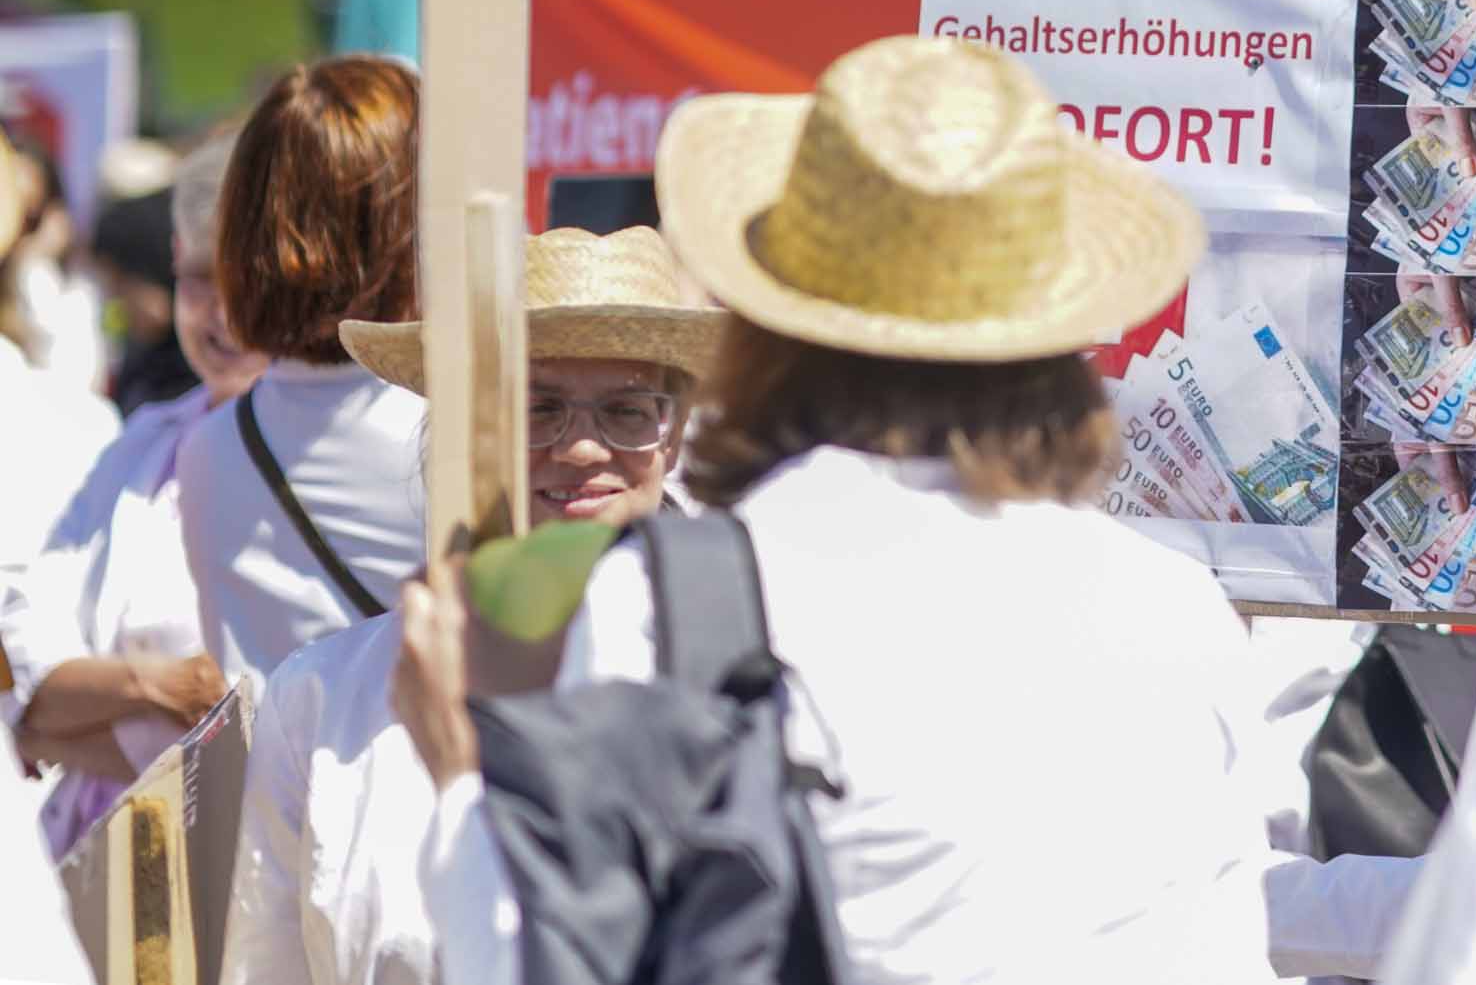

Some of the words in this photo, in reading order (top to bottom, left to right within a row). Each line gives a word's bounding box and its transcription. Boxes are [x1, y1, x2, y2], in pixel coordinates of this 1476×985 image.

[934, 16, 1312, 67] Gehaltserhöhungen
[1425, 46, 1455, 73] 10
[1417, 214, 1448, 241] 10
[1168, 357, 1192, 380] 5
[1185, 378, 1213, 416] EURO
[1407, 385, 1438, 411] 10
[1150, 398, 1176, 429] 10
[1174, 425, 1204, 460] EURO
[1122, 416, 1151, 451] 50
[1152, 445, 1184, 479] EURO
[1134, 472, 1167, 500] EURO
[1407, 551, 1438, 579] 10
